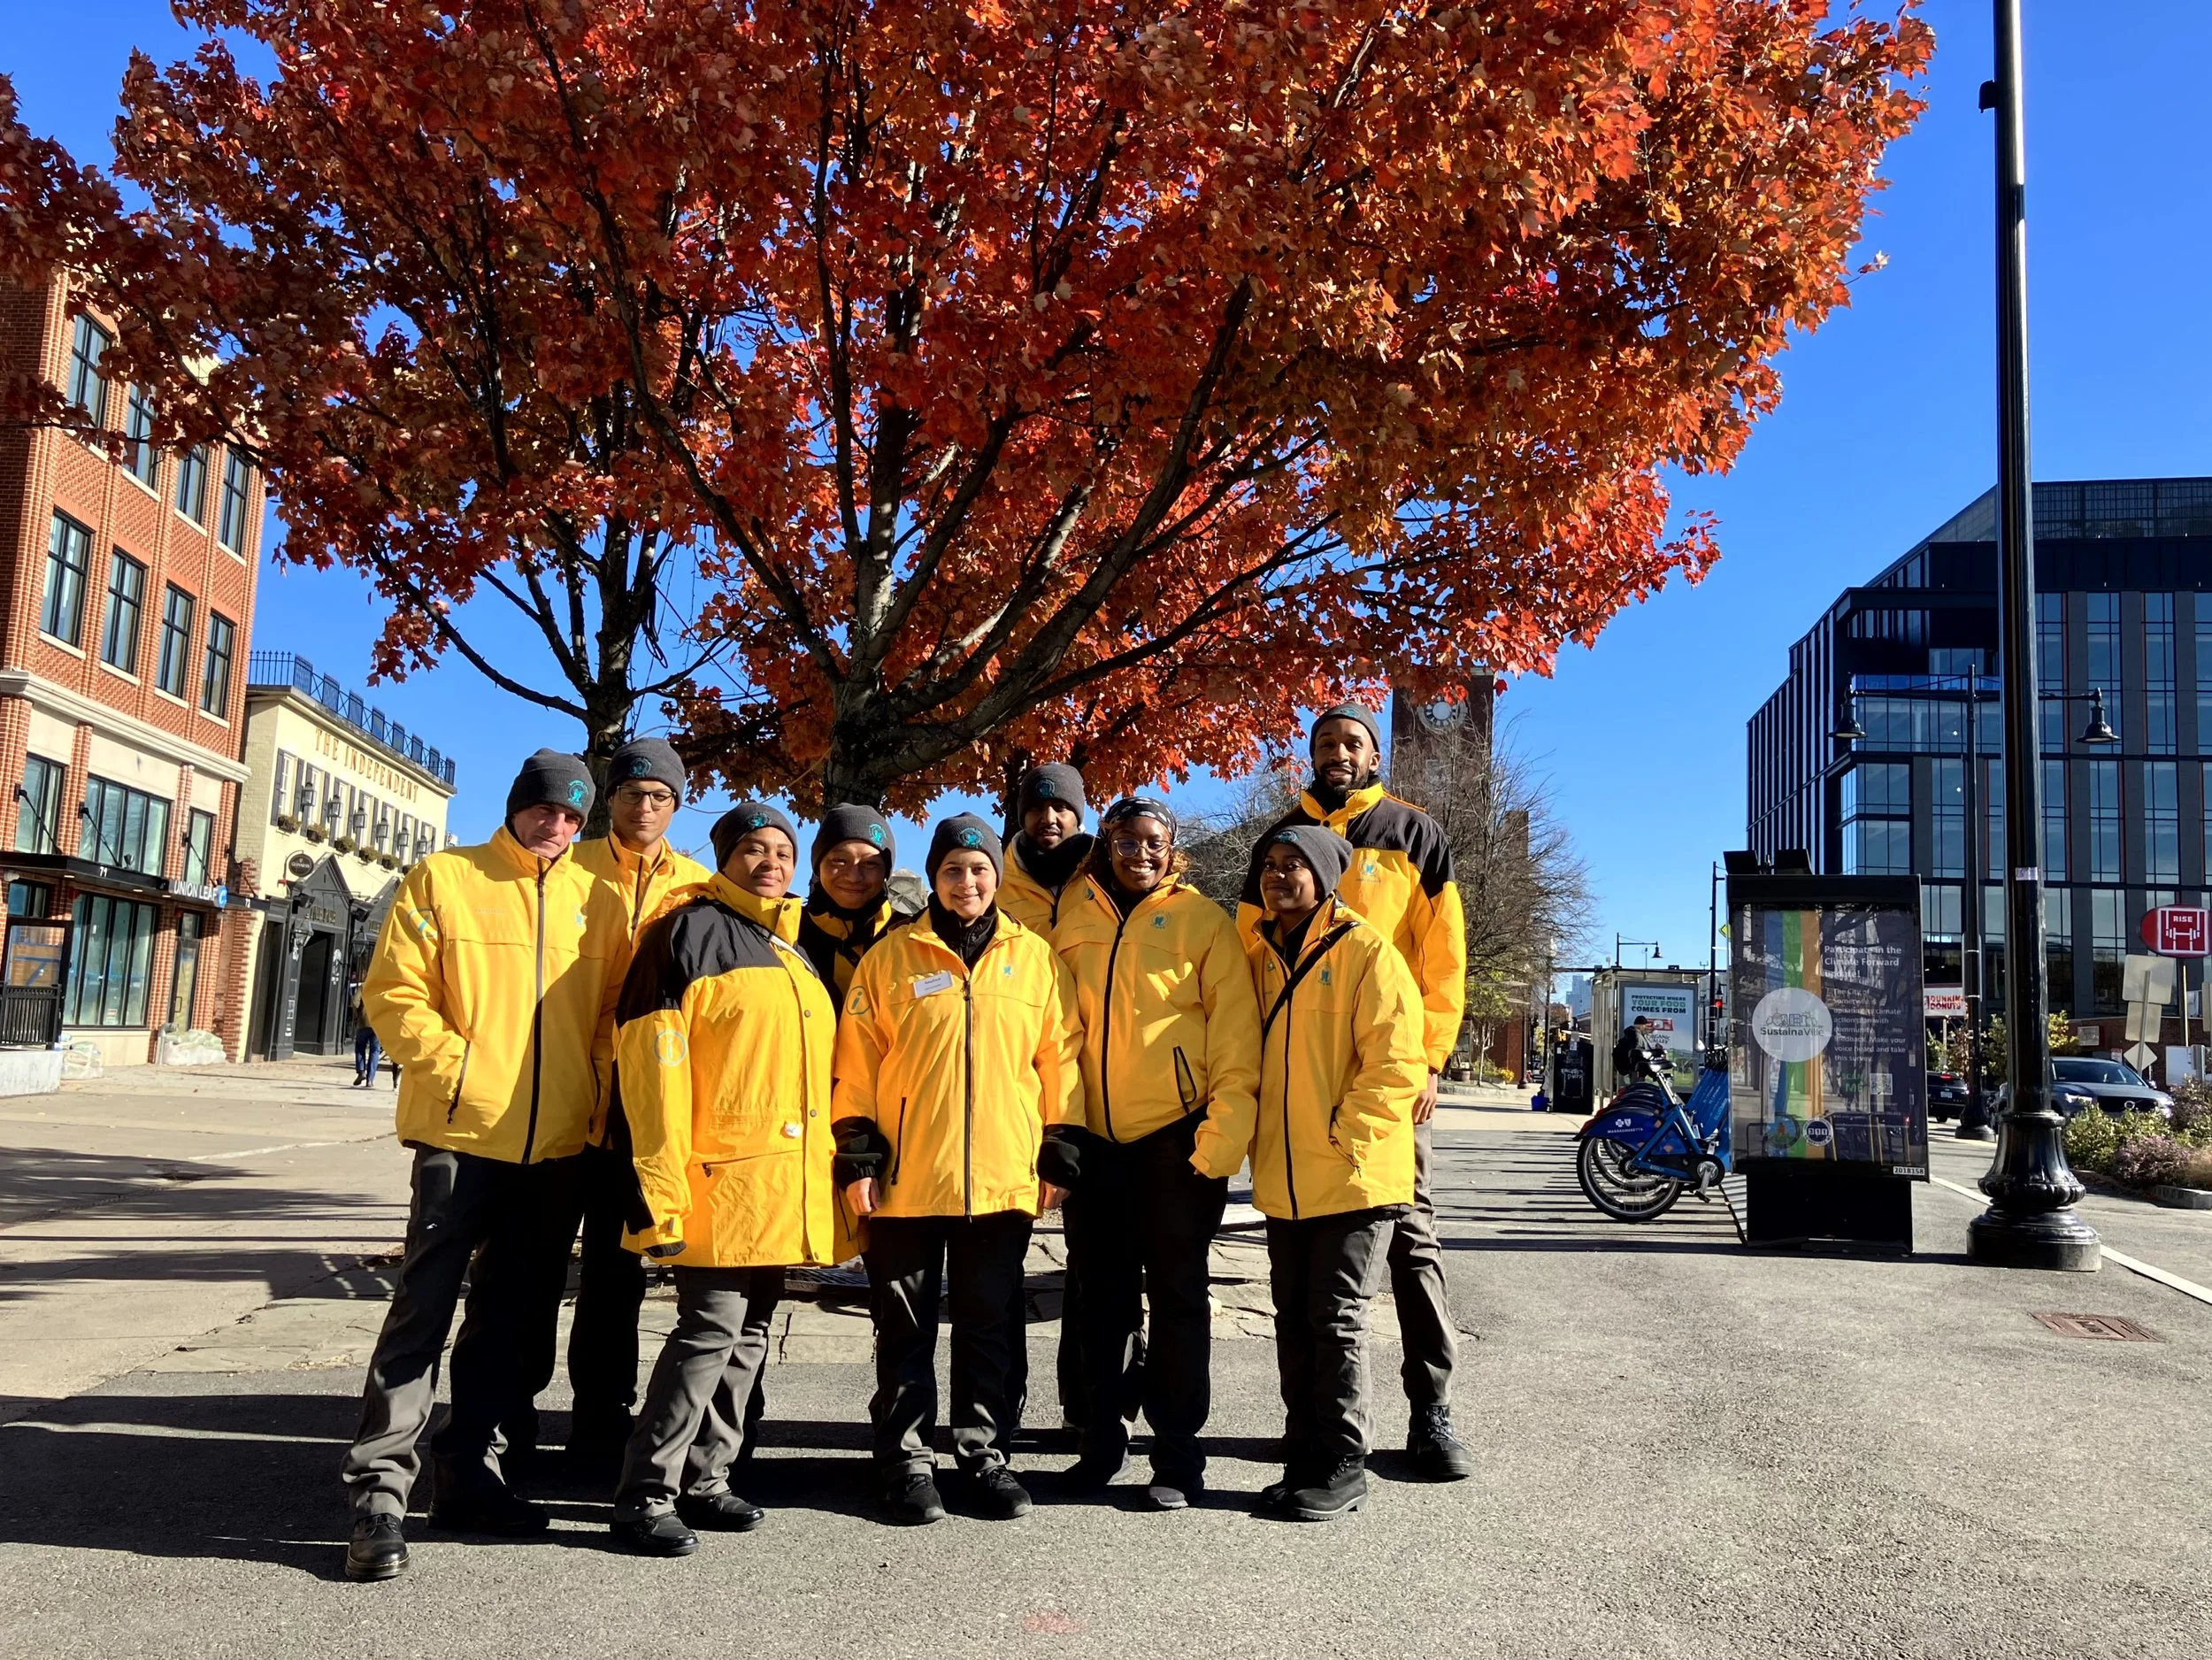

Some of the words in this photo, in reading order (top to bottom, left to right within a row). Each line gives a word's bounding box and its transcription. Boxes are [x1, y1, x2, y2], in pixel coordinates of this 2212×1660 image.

[315, 729, 340, 761] THE
[344, 746, 419, 803] INDEPENDENT
[99, 866, 108, 878] 71
[173, 880, 198, 898] UNION
[199, 885, 218, 902] LEAF
[1862, 957, 1900, 966] Forward
[1760, 1026, 1824, 1036] SustainaVille
